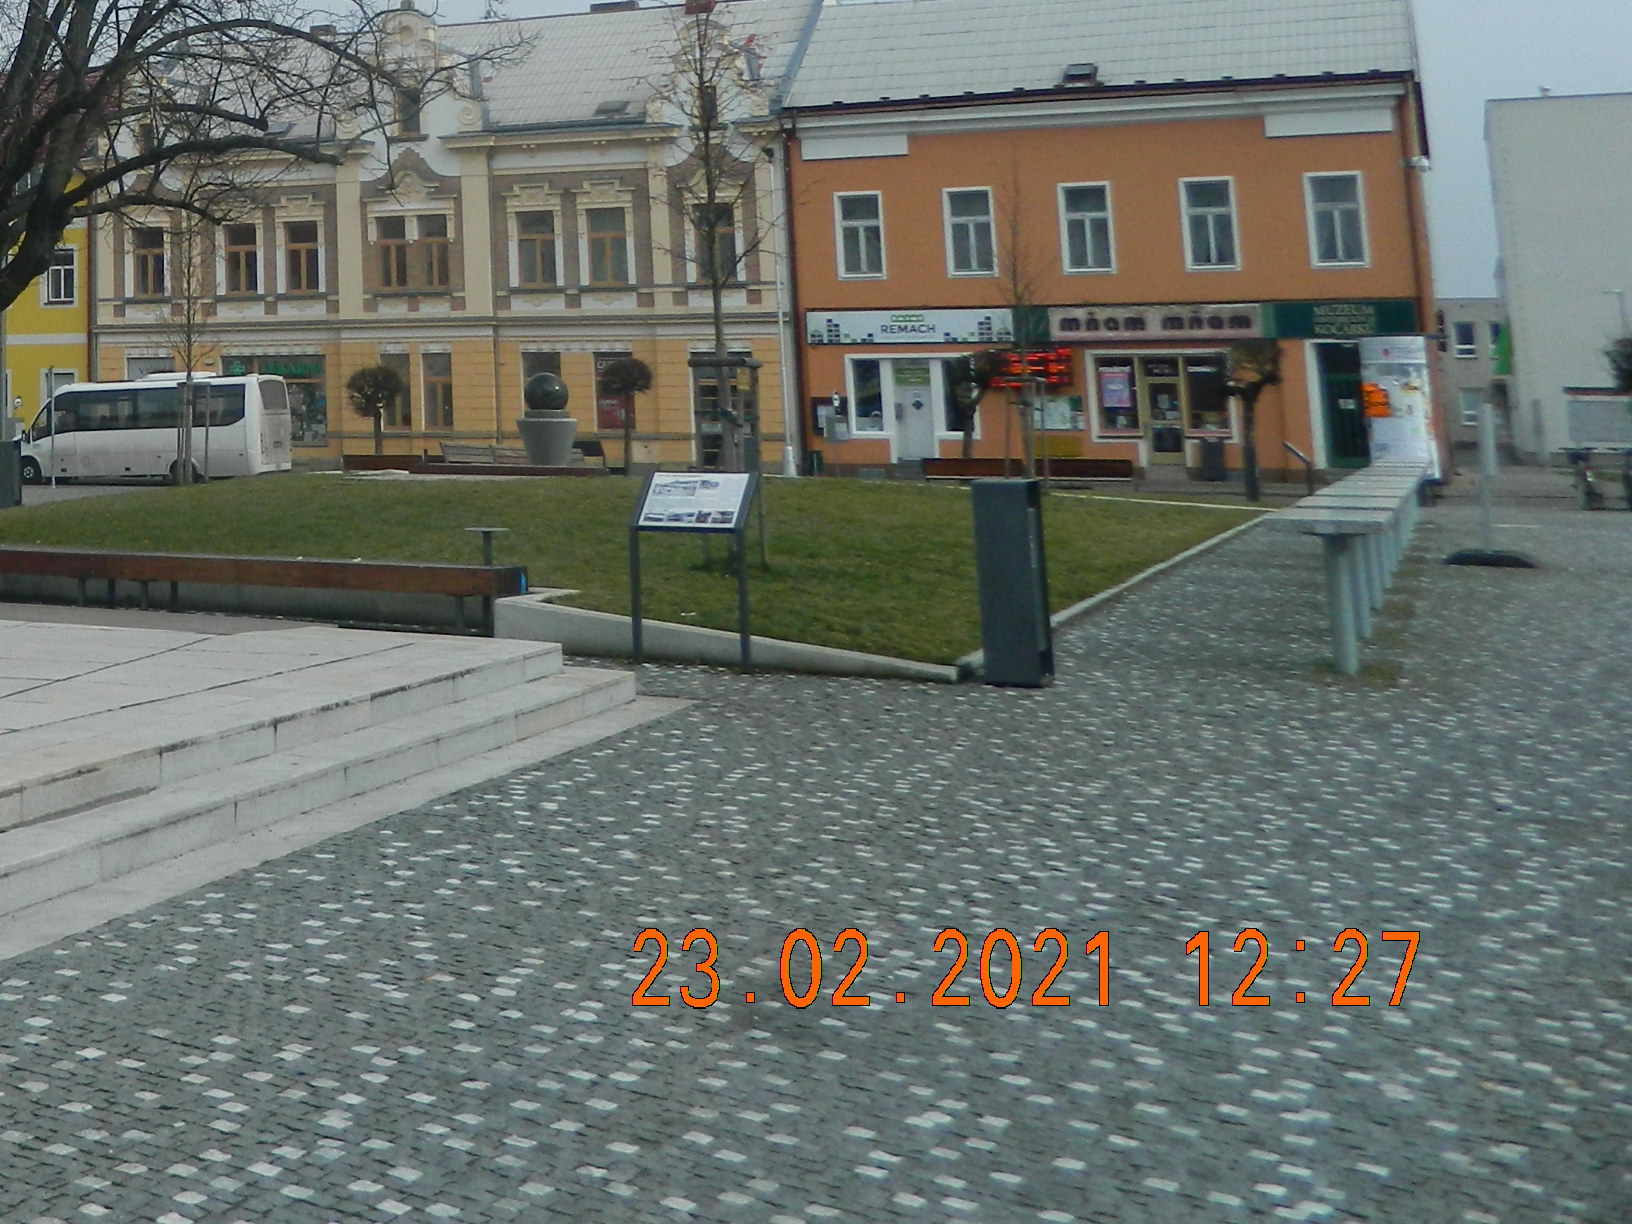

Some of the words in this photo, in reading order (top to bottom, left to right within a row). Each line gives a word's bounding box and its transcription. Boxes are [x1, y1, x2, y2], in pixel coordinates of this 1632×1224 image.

[1058, 310, 1146, 332] mňam
[1161, 309, 1252, 330] mňam
[880, 324, 937, 334] REMACH
